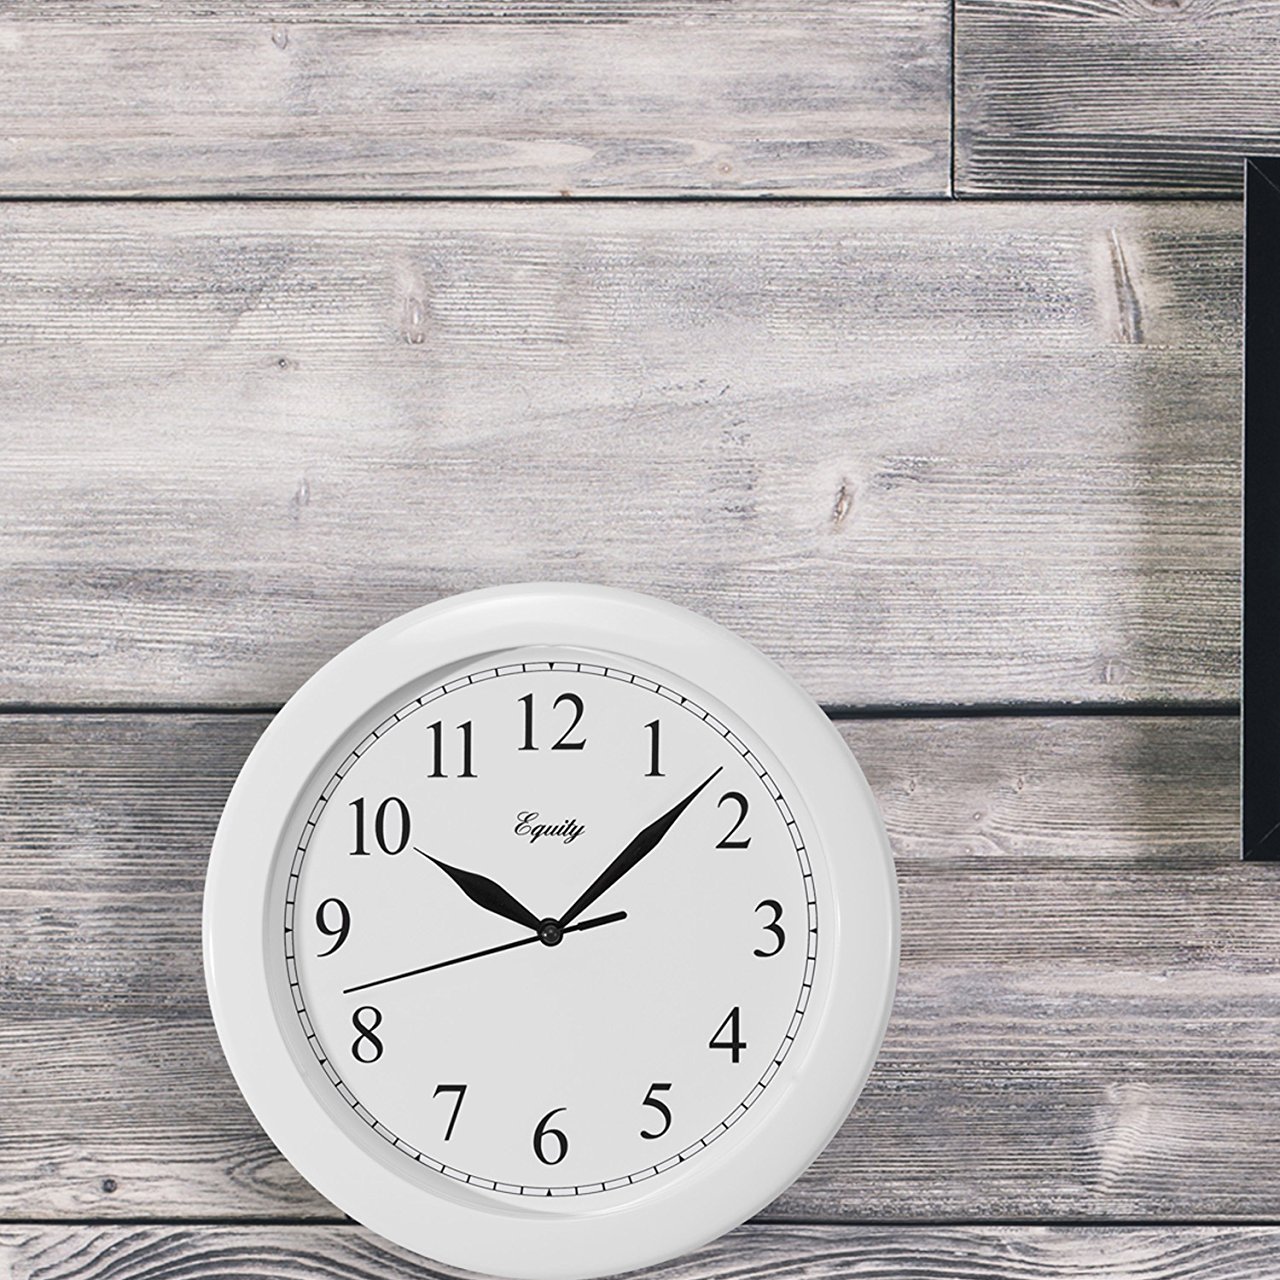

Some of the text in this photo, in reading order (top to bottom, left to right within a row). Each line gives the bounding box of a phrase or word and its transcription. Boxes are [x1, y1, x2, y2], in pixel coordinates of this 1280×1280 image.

[427, 721, 477, 777] 11
[518, 693, 586, 750] 12
[645, 720, 665, 776] 1
[349, 797, 410, 855] 10
[514, 811, 586, 844] Equity
[716, 792, 751, 848] 2
[316, 898, 350, 957] 9
[754, 900, 785, 957] 3
[352, 1006, 383, 1063] 8
[709, 1007, 746, 1063] 4
[433, 1085, 467, 1141] 7
[533, 1108, 568, 1165] 6
[640, 1083, 672, 1139] 5
